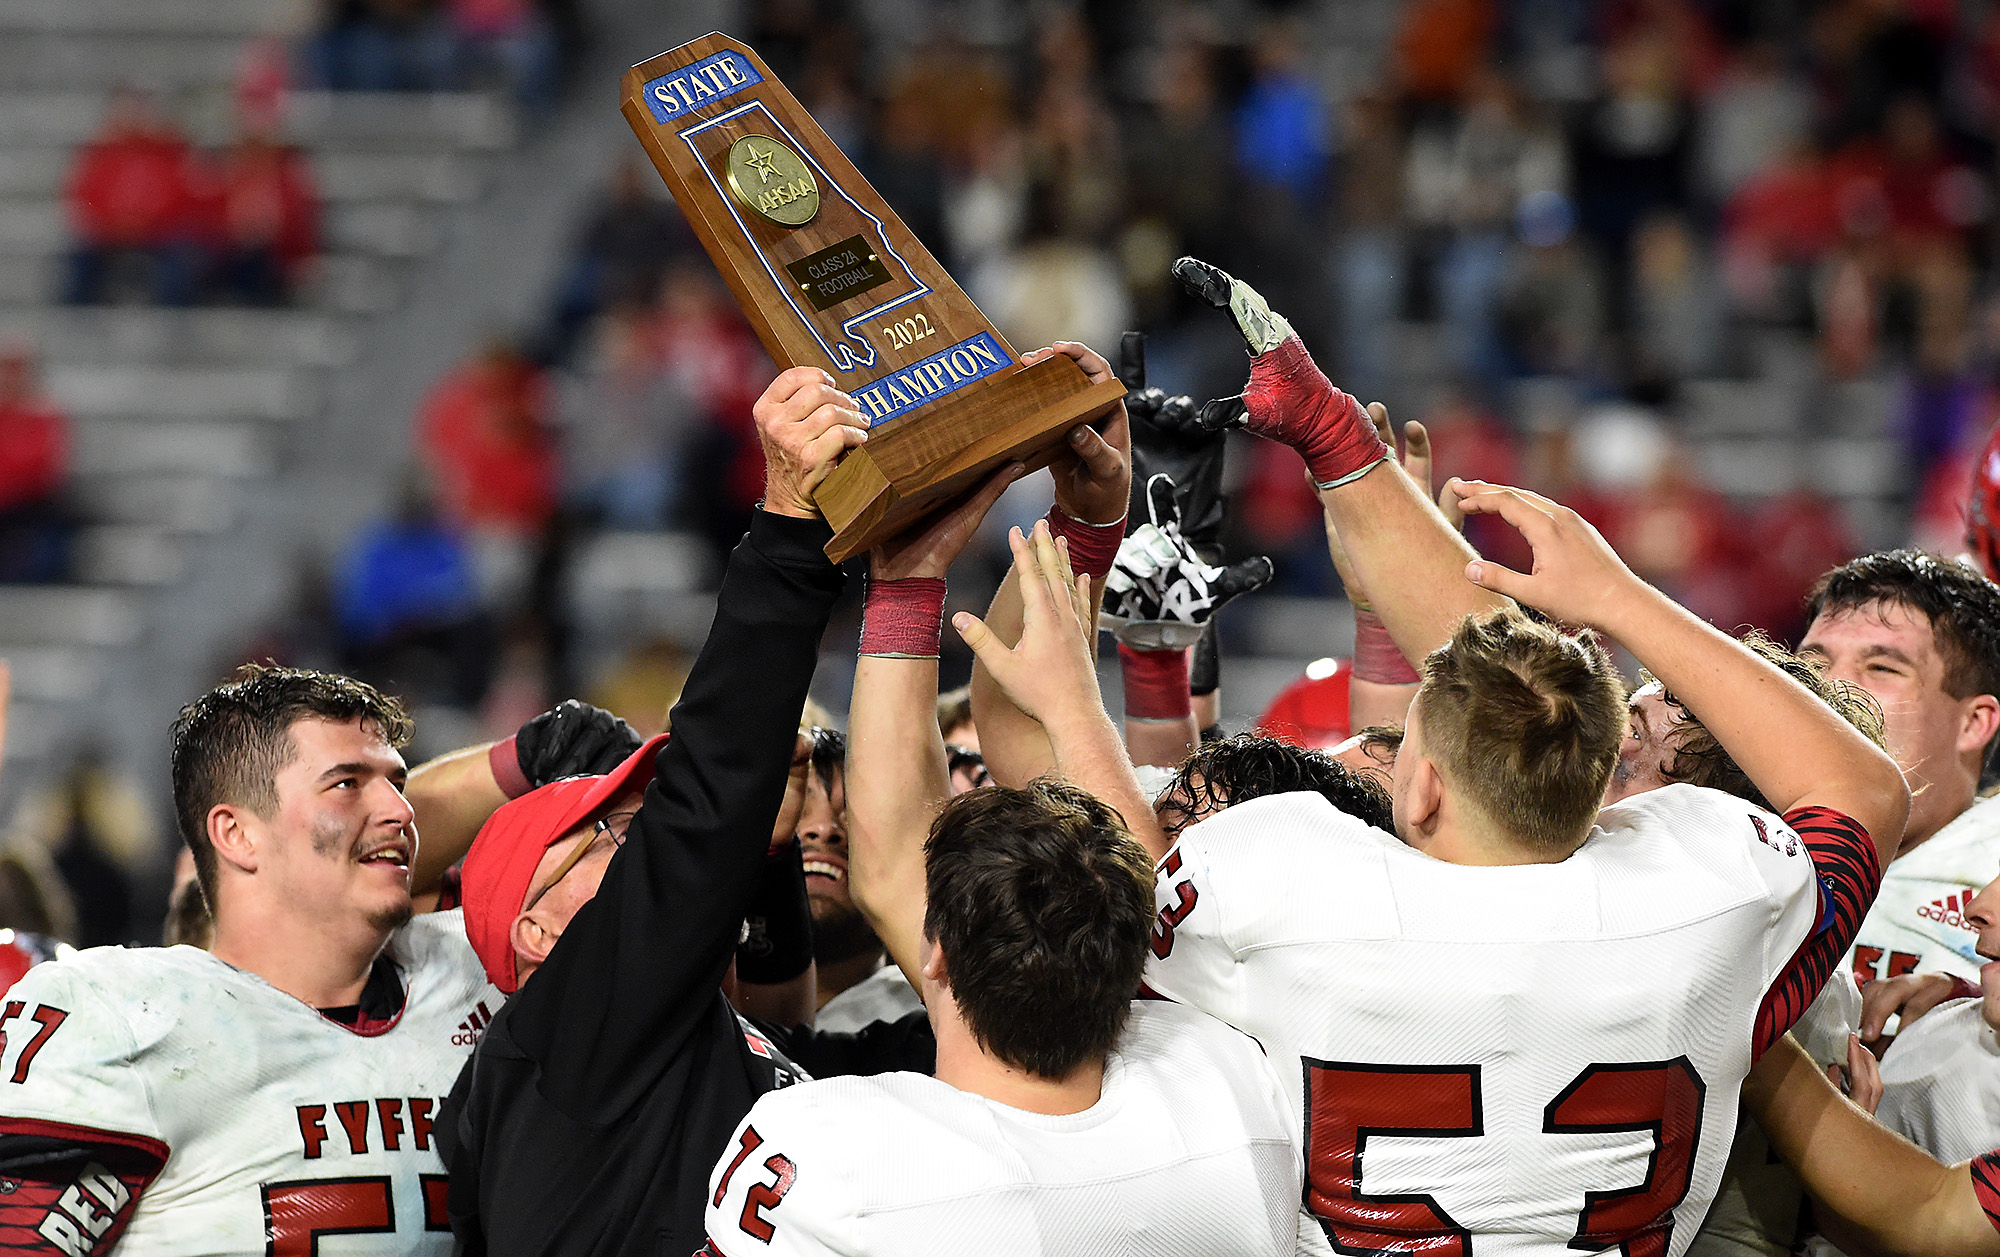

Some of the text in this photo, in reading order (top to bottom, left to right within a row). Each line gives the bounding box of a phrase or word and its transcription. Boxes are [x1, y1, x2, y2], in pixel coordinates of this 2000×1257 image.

[654, 56, 748, 114] STATE
[757, 177, 817, 213] AHSAA
[808, 250, 860, 281] CLASS 2A
[817, 265, 874, 297] FOOTBALL
[883, 313, 936, 351] 2022
[854, 339, 999, 420] HAMPION
[296, 1097, 449, 1160] FYFF
[1301, 1054, 1707, 1257] 53
[38, 1161, 132, 1257] RED
